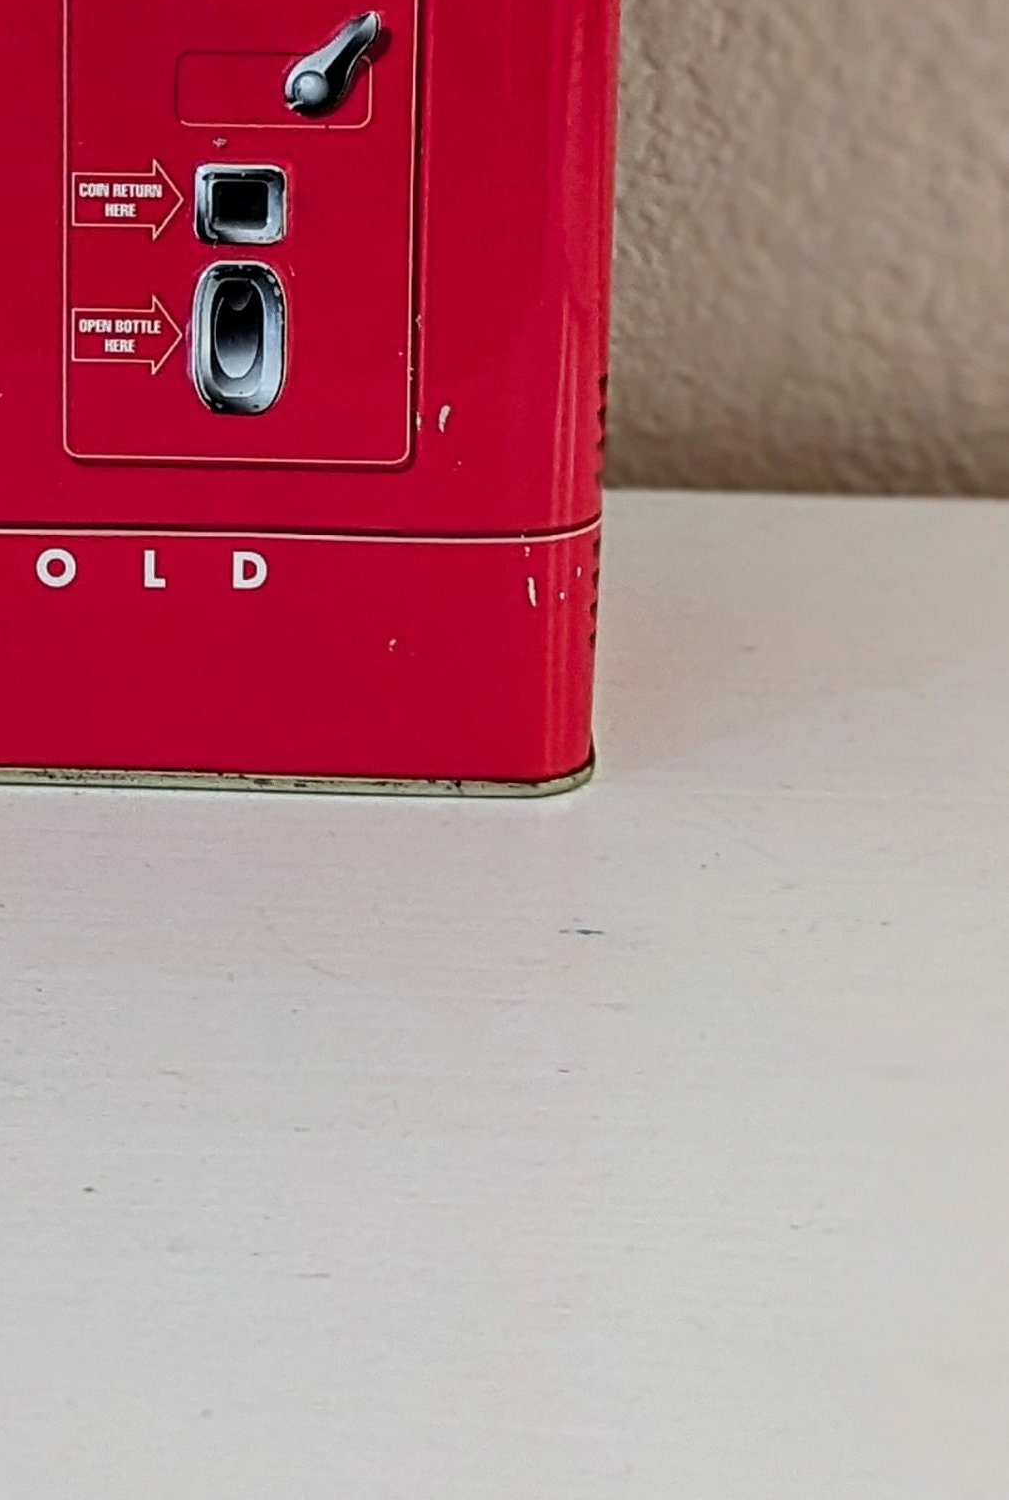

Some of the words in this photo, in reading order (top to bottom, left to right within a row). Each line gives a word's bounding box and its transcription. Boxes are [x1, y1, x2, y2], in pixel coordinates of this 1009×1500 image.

[78, 182, 110, 198] COIN
[112, 183, 163, 198] RETURN
[104, 203, 137, 218] HERE
[78, 318, 112, 333] OPEN
[114, 319, 162, 334] BOTTLE
[104, 338, 136, 353] HERE
